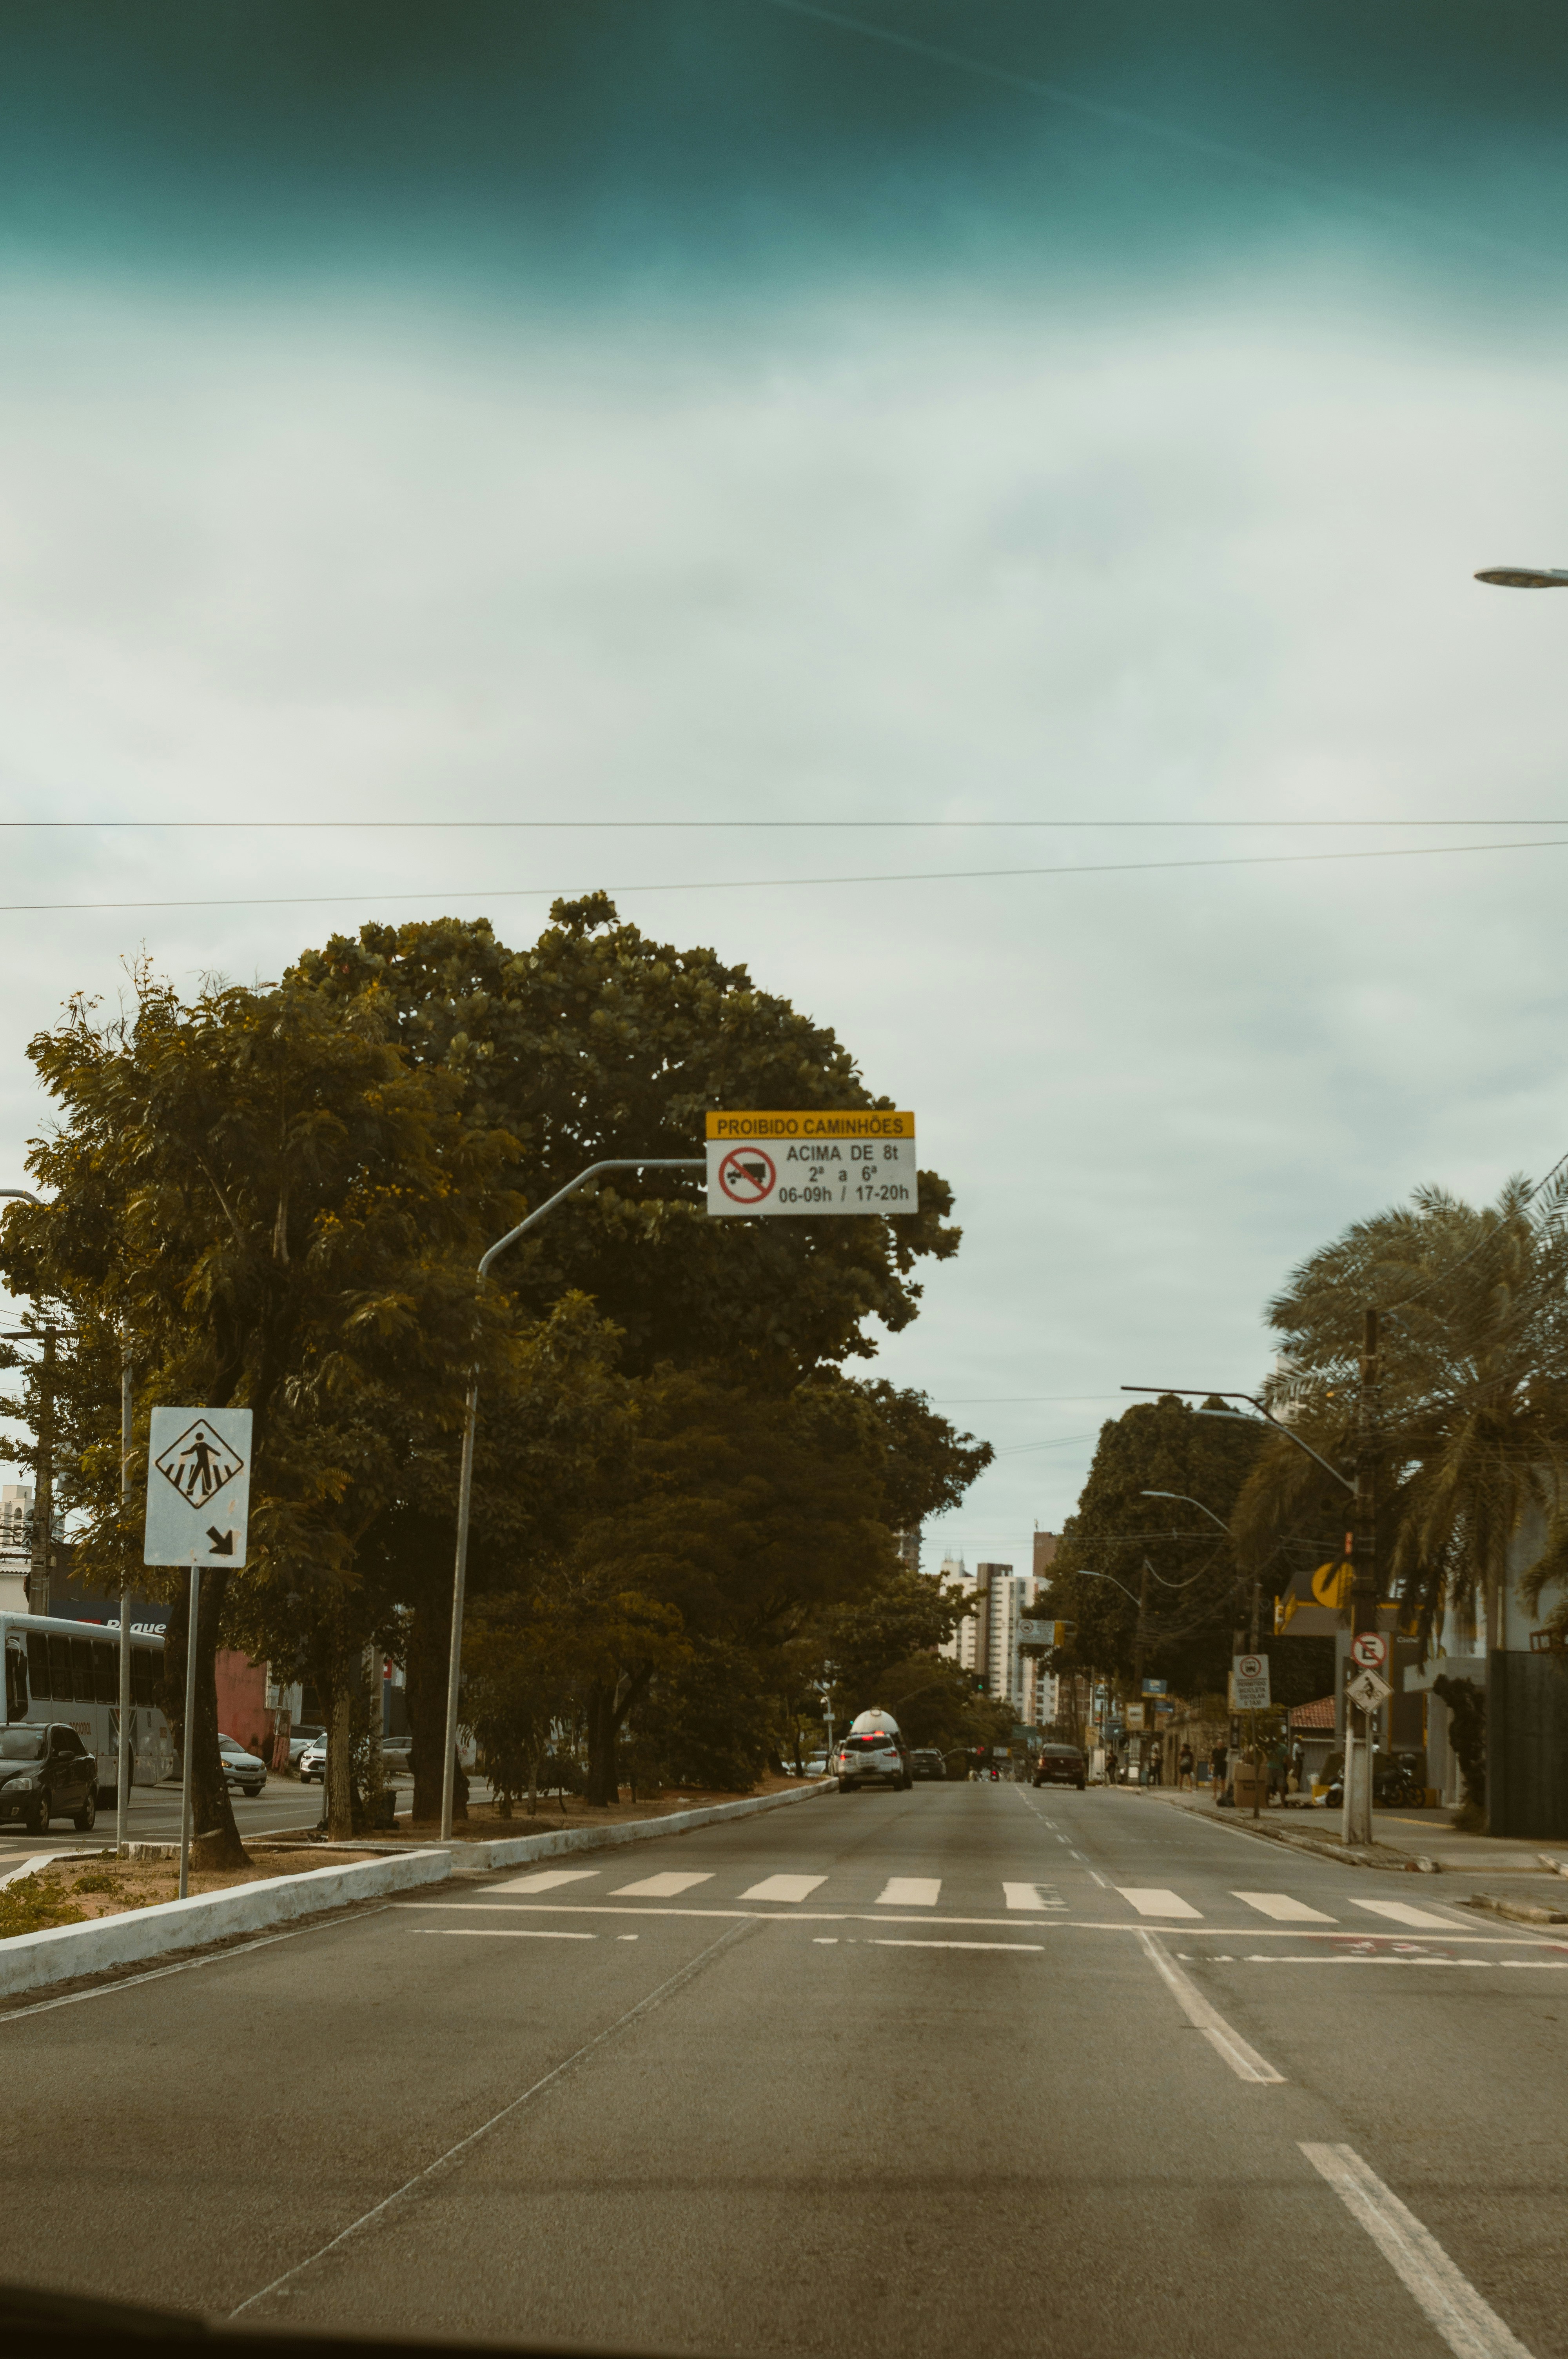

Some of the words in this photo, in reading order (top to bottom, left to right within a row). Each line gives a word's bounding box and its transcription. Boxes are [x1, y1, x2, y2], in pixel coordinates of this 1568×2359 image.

[717, 1119, 799, 1135] PROIBIDO
[803, 1115, 903, 1134] CAMINHÕES
[786, 1145, 842, 1161] ACIMA
[850, 1145, 874, 1161] DE
[883, 1144, 898, 1161] 8t
[838, 1169, 848, 1182] a
[779, 1185, 832, 1203] 06-09h
[840, 1185, 847, 1202] /
[856, 1183, 909, 1201] 17-20h
[1362, 1641, 1376, 1659] E
